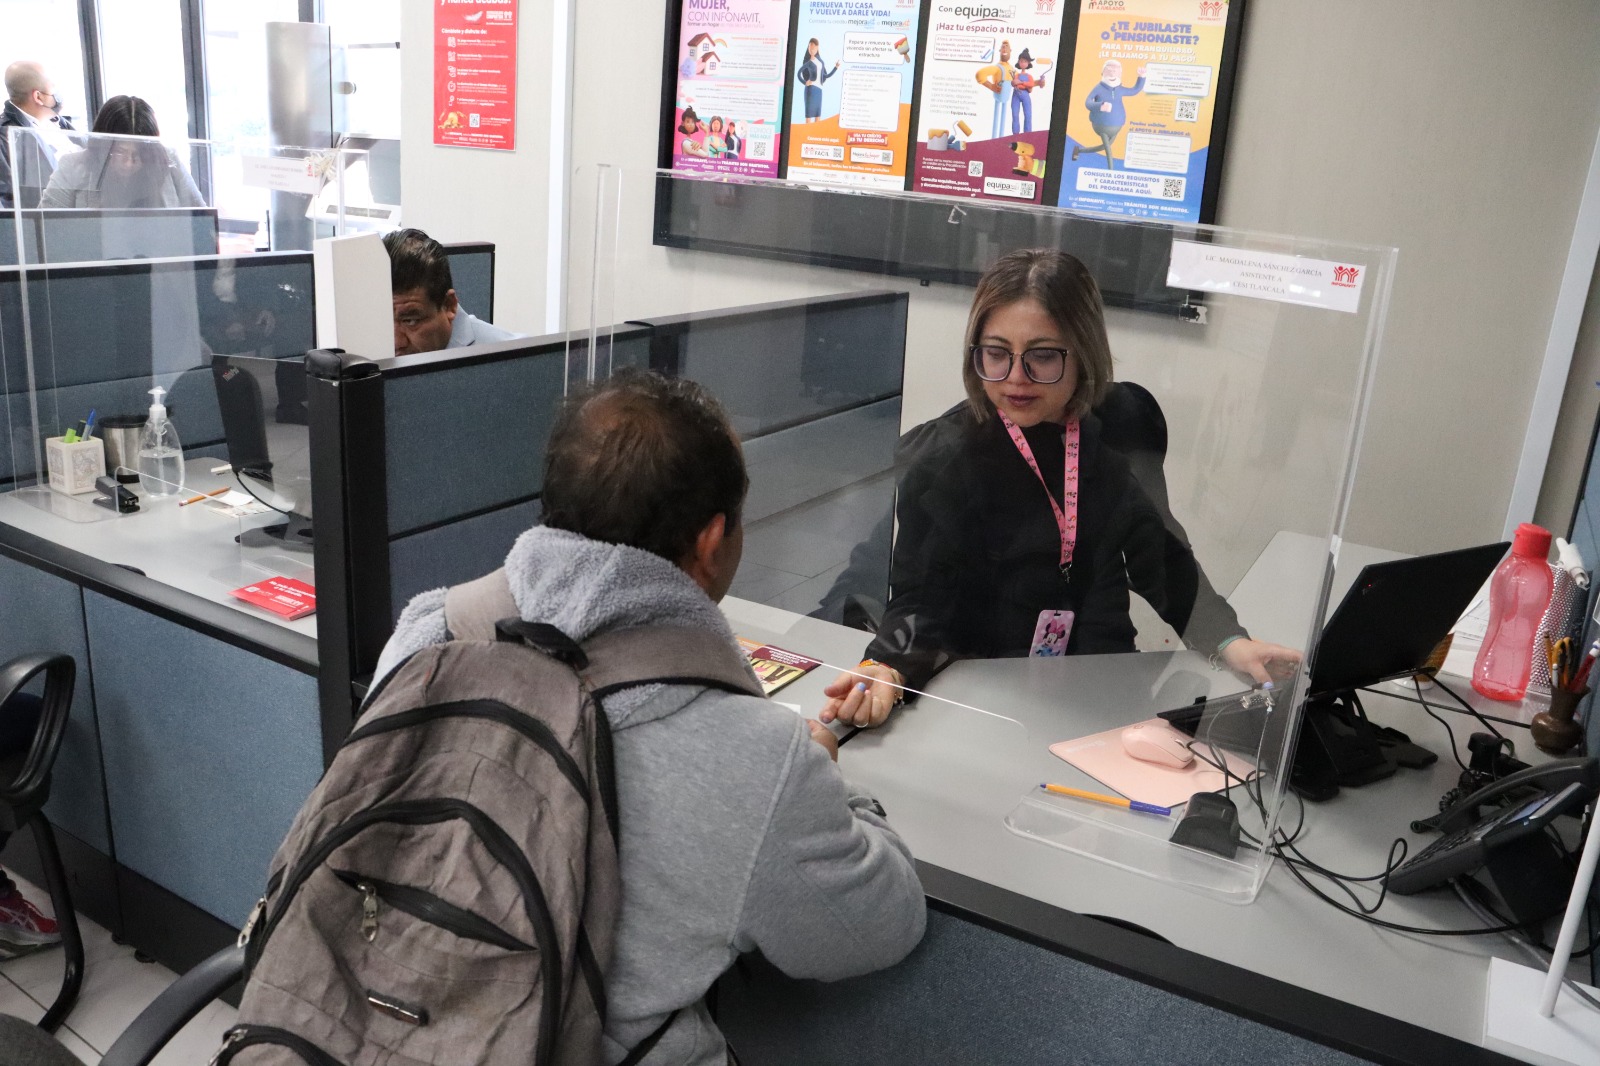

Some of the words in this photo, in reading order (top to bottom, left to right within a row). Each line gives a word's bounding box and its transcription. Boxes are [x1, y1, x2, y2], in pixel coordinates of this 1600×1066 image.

[688, 0, 730, 11] MUJER,
[954, 4, 999, 19] equipa
[688, 12, 709, 22] CON
[712, 12, 760, 23] INFONAVIT,
[936, 23, 954, 31] ¡Haz
[966, 25, 998, 33] espacio
[1110, 21, 1130, 32] ¿TE
[1132, 22, 1192, 34] JUBILASTE
[1114, 32, 1199, 45] PENSIONASTE?
[1127, 174, 1160, 183] REQUISITOS
[986, 181, 1010, 191] equipa
[1100, 184, 1134, 193] PROGRAMA
[1219, 256, 1262, 269] MAGDALENA
[1264, 262, 1295, 273] SÁNCHEZ
[1296, 266, 1323, 277] GARCÍA
[1240, 271, 1276, 282] ASISTENTE
[1250, 284, 1285, 295] TLAXCALA
